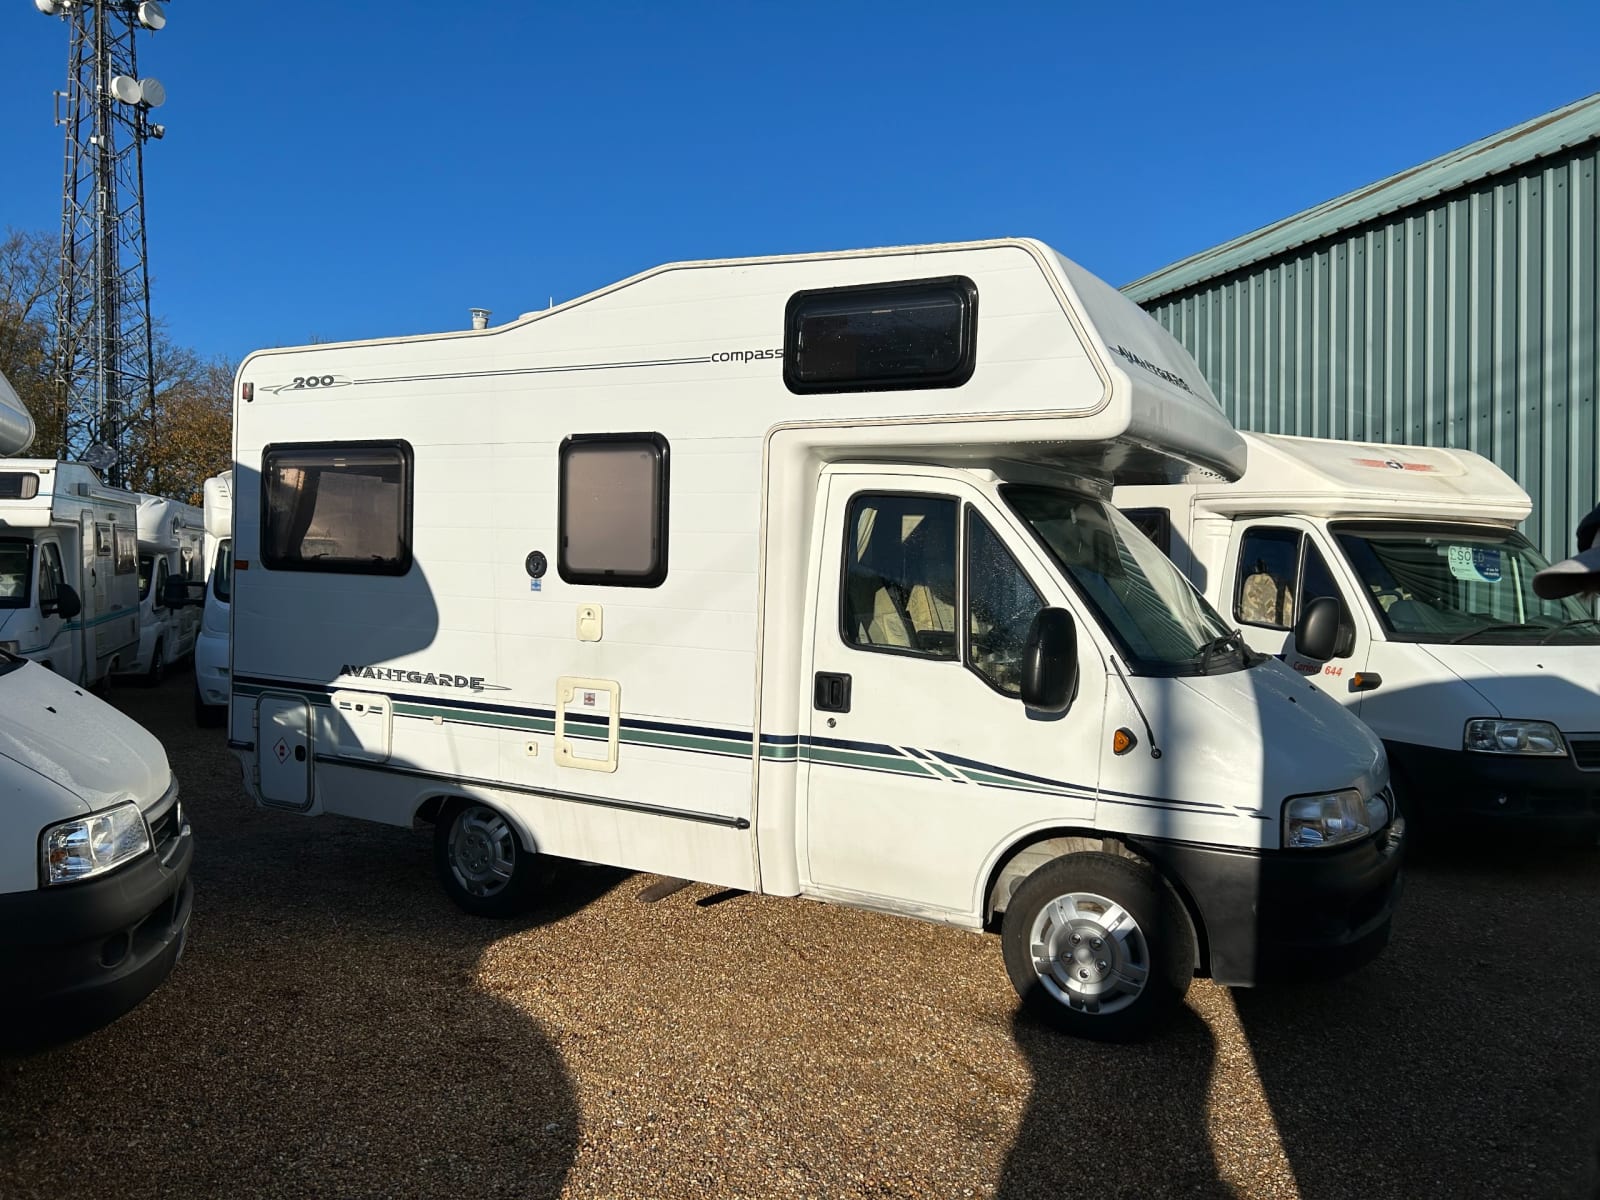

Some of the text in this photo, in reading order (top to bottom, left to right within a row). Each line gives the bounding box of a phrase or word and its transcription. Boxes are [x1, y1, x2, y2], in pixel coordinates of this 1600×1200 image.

[711, 348, 785, 364] compass
[293, 375, 335, 389] 200
[339, 664, 485, 690] AVANTGARDE
[1324, 665, 1343, 677] 644
